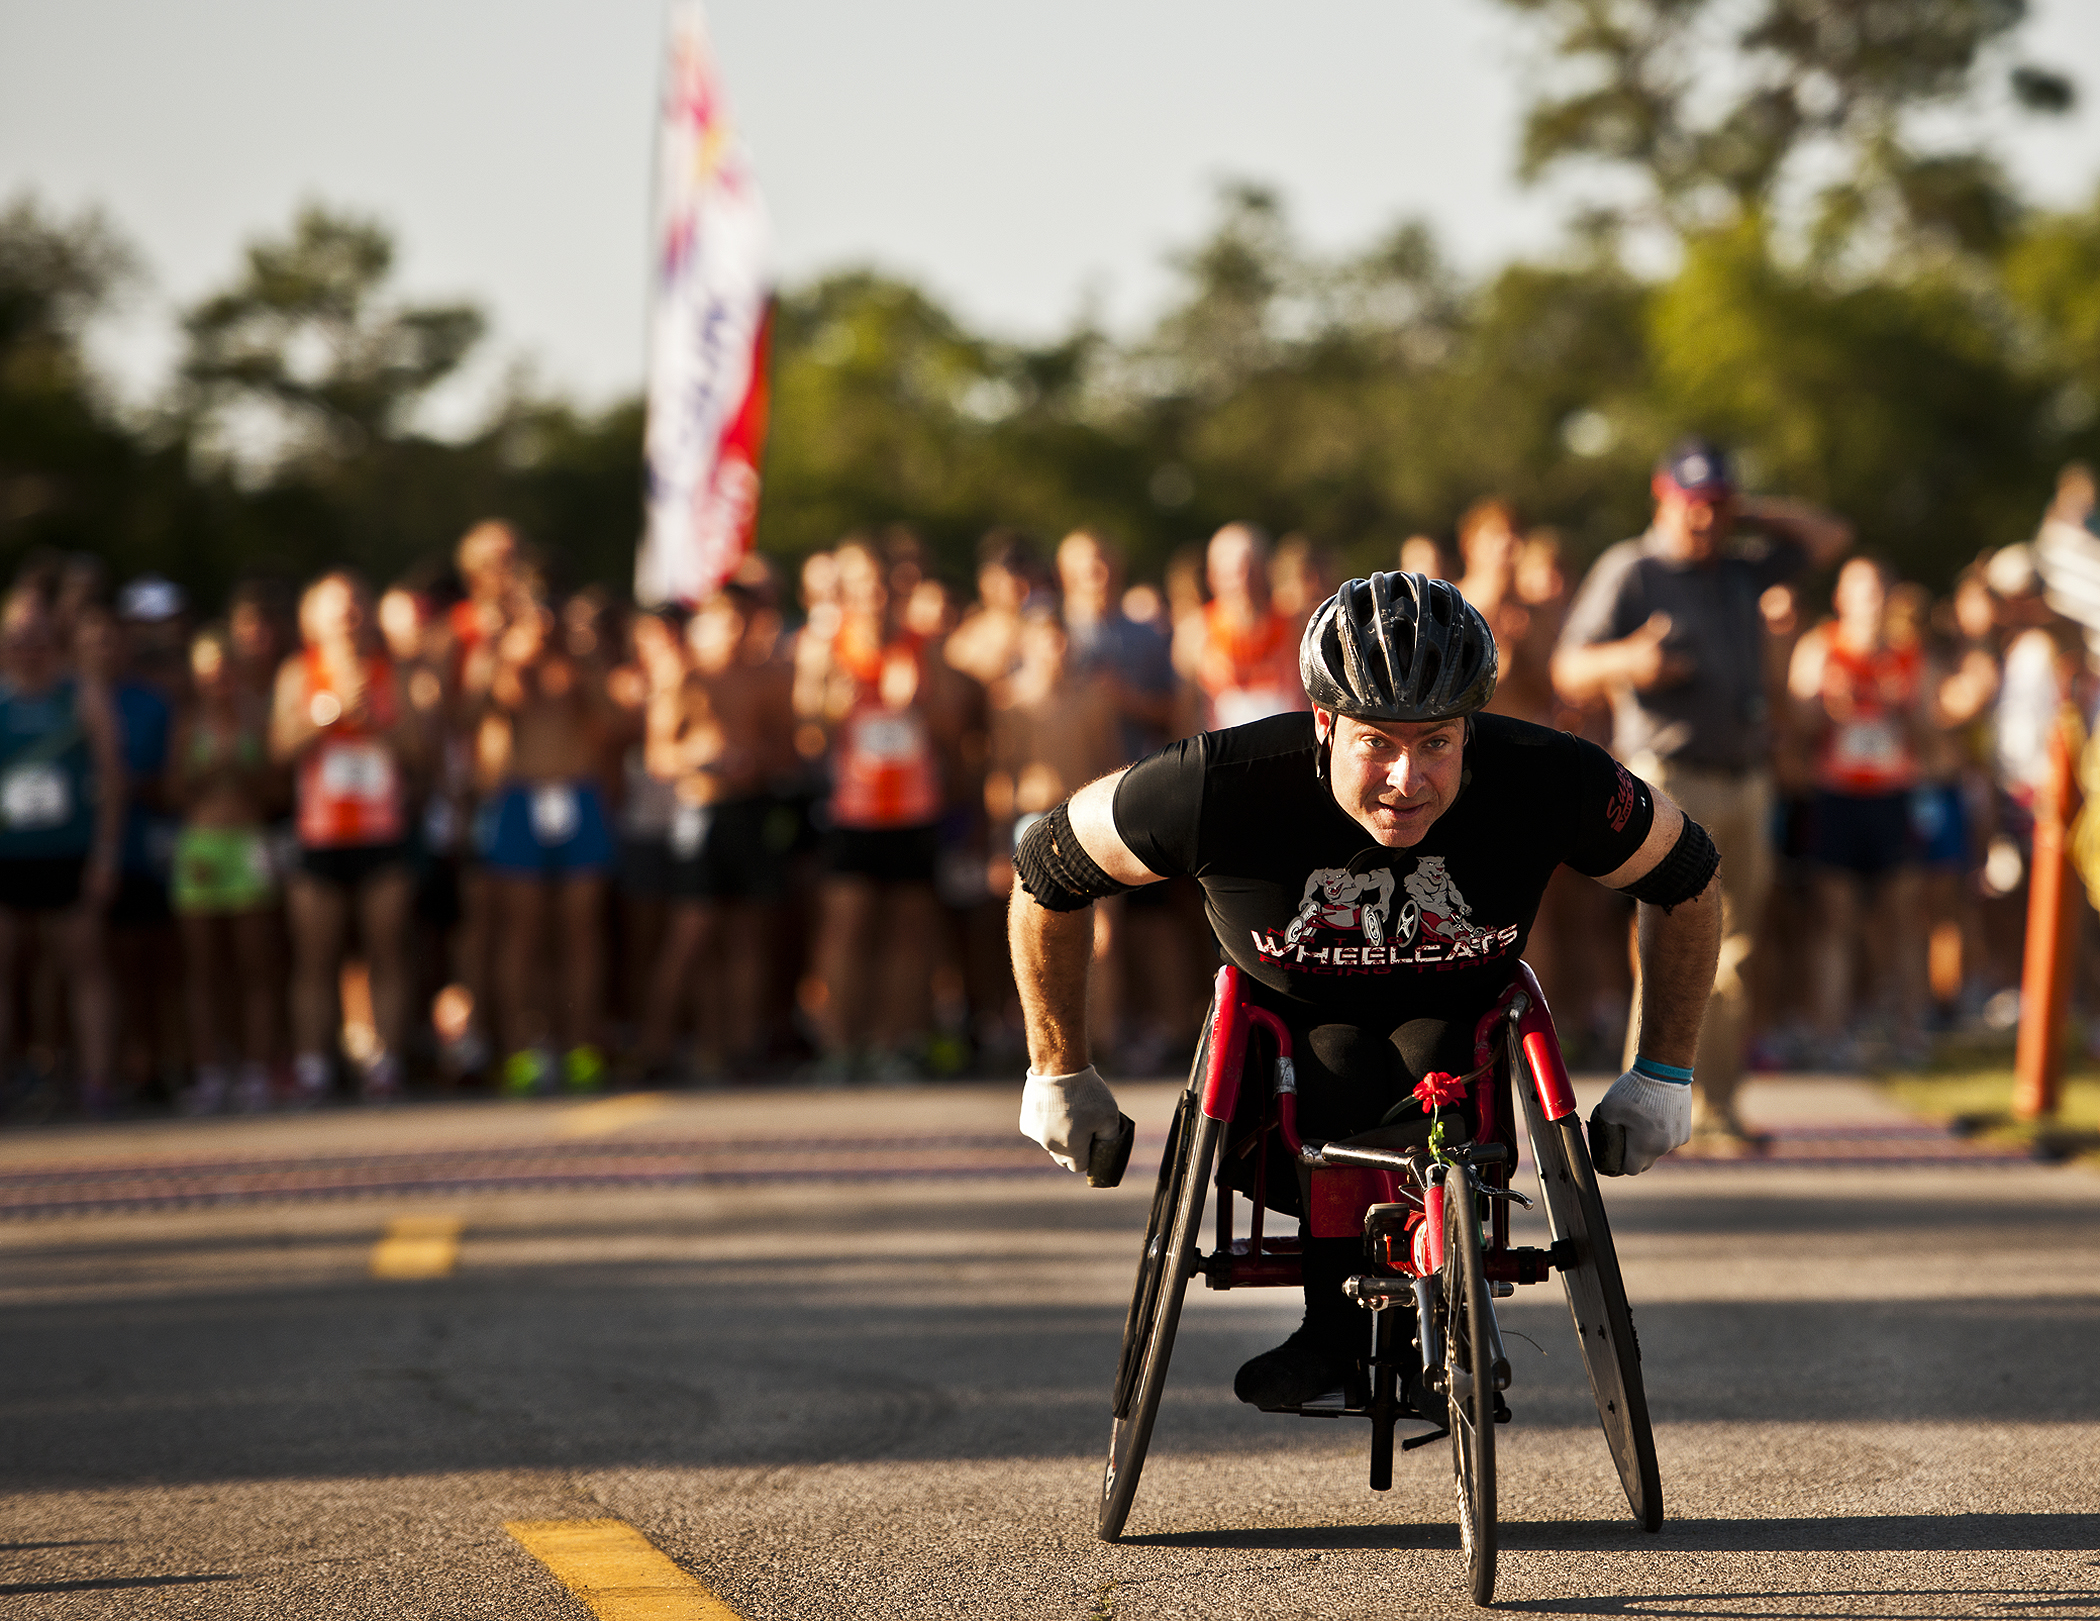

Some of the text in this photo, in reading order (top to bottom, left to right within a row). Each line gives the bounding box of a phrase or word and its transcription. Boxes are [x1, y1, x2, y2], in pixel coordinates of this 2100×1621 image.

[1250, 923, 1518, 966] WHEELCATS
[1259, 949, 1506, 977] RACING TEAM
